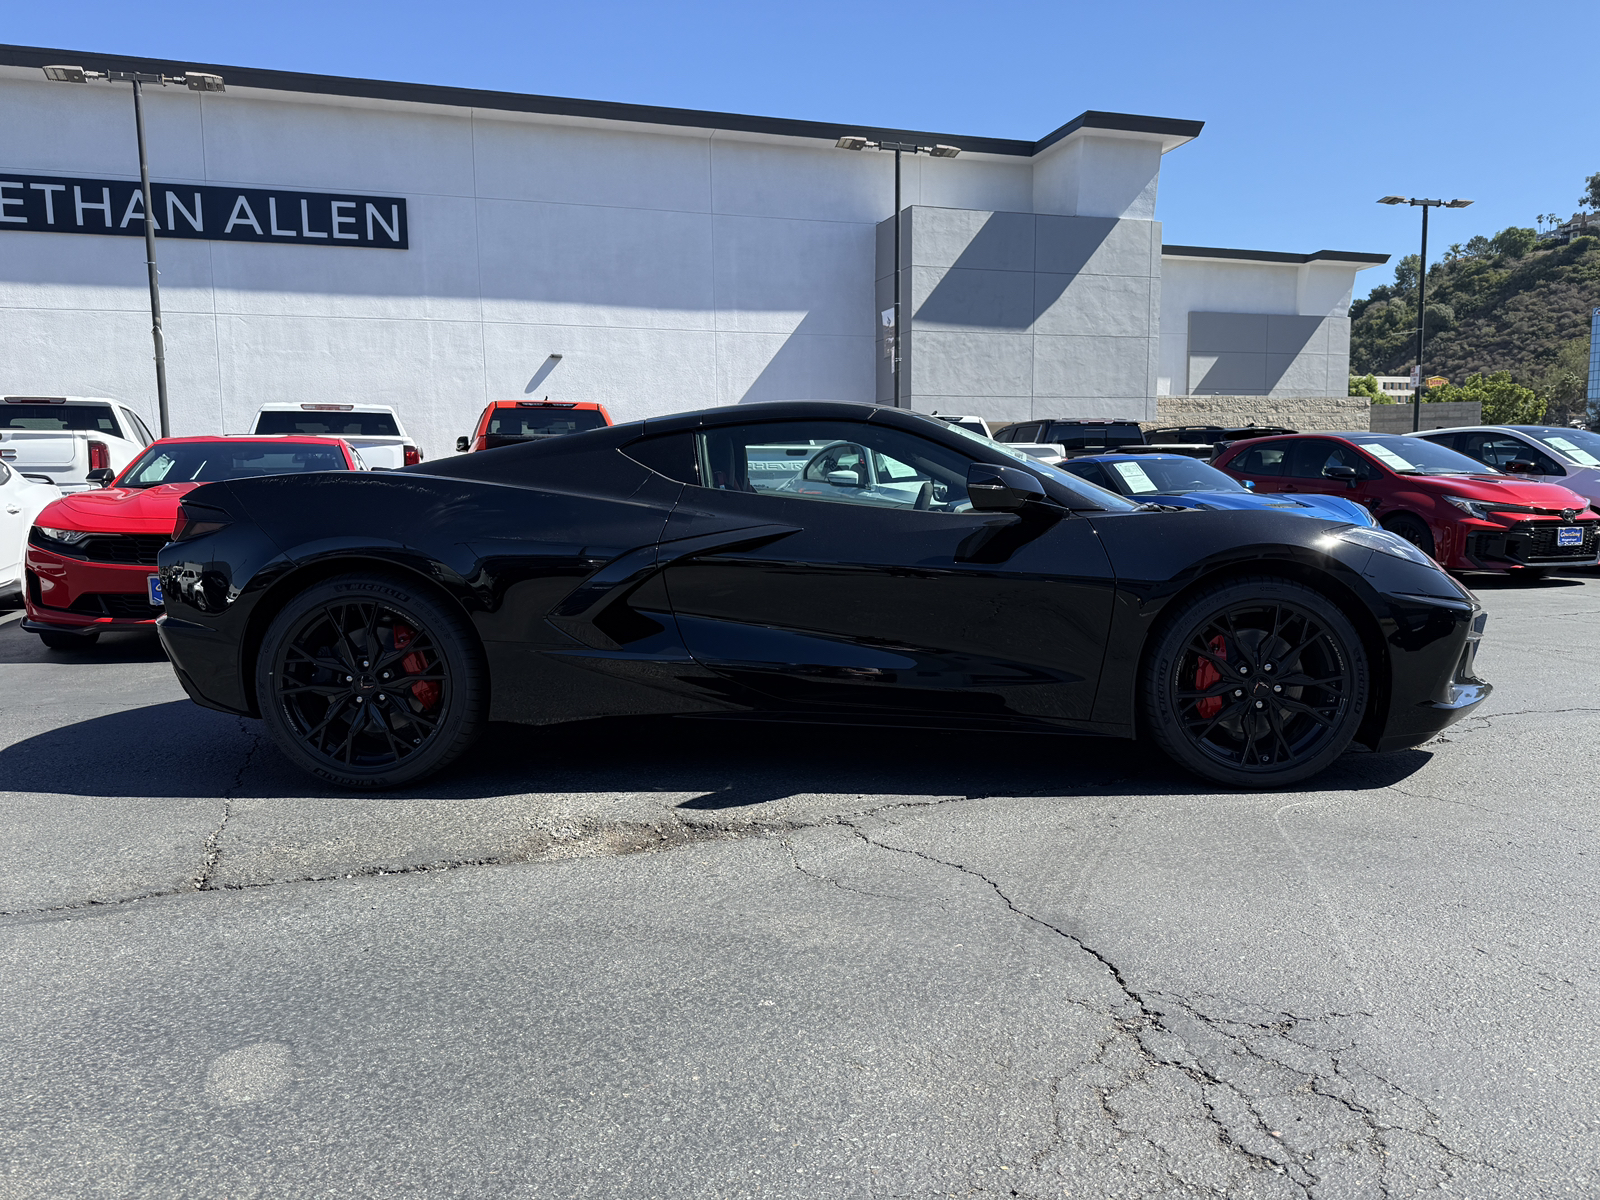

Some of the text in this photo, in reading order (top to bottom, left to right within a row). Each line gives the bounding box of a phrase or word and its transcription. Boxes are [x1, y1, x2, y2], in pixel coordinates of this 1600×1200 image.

[0, 180, 400, 242] ETHAN ALLEN
[350, 583, 408, 600] MICHELIN
[1158, 659, 1168, 710] MICHELIN
[1354, 660, 1364, 711] MICHELIN
[316, 769, 372, 786] MICHELIN
